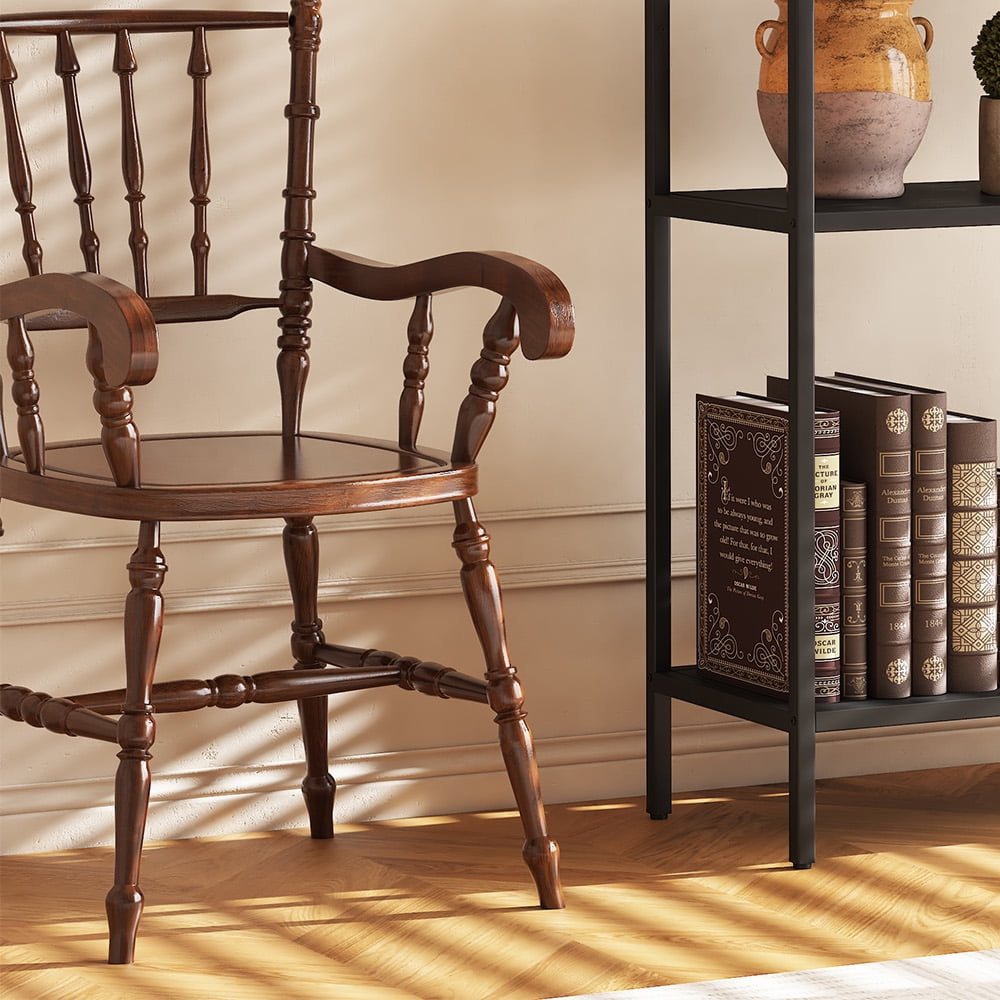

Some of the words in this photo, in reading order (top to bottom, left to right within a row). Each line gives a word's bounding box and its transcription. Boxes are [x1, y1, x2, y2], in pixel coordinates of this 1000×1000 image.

[815, 470, 838, 478] CTURE
[751, 499, 761, 508] who
[764, 517, 773, 526] and
[730, 537, 738, 546] For
[720, 551, 734, 560] would
